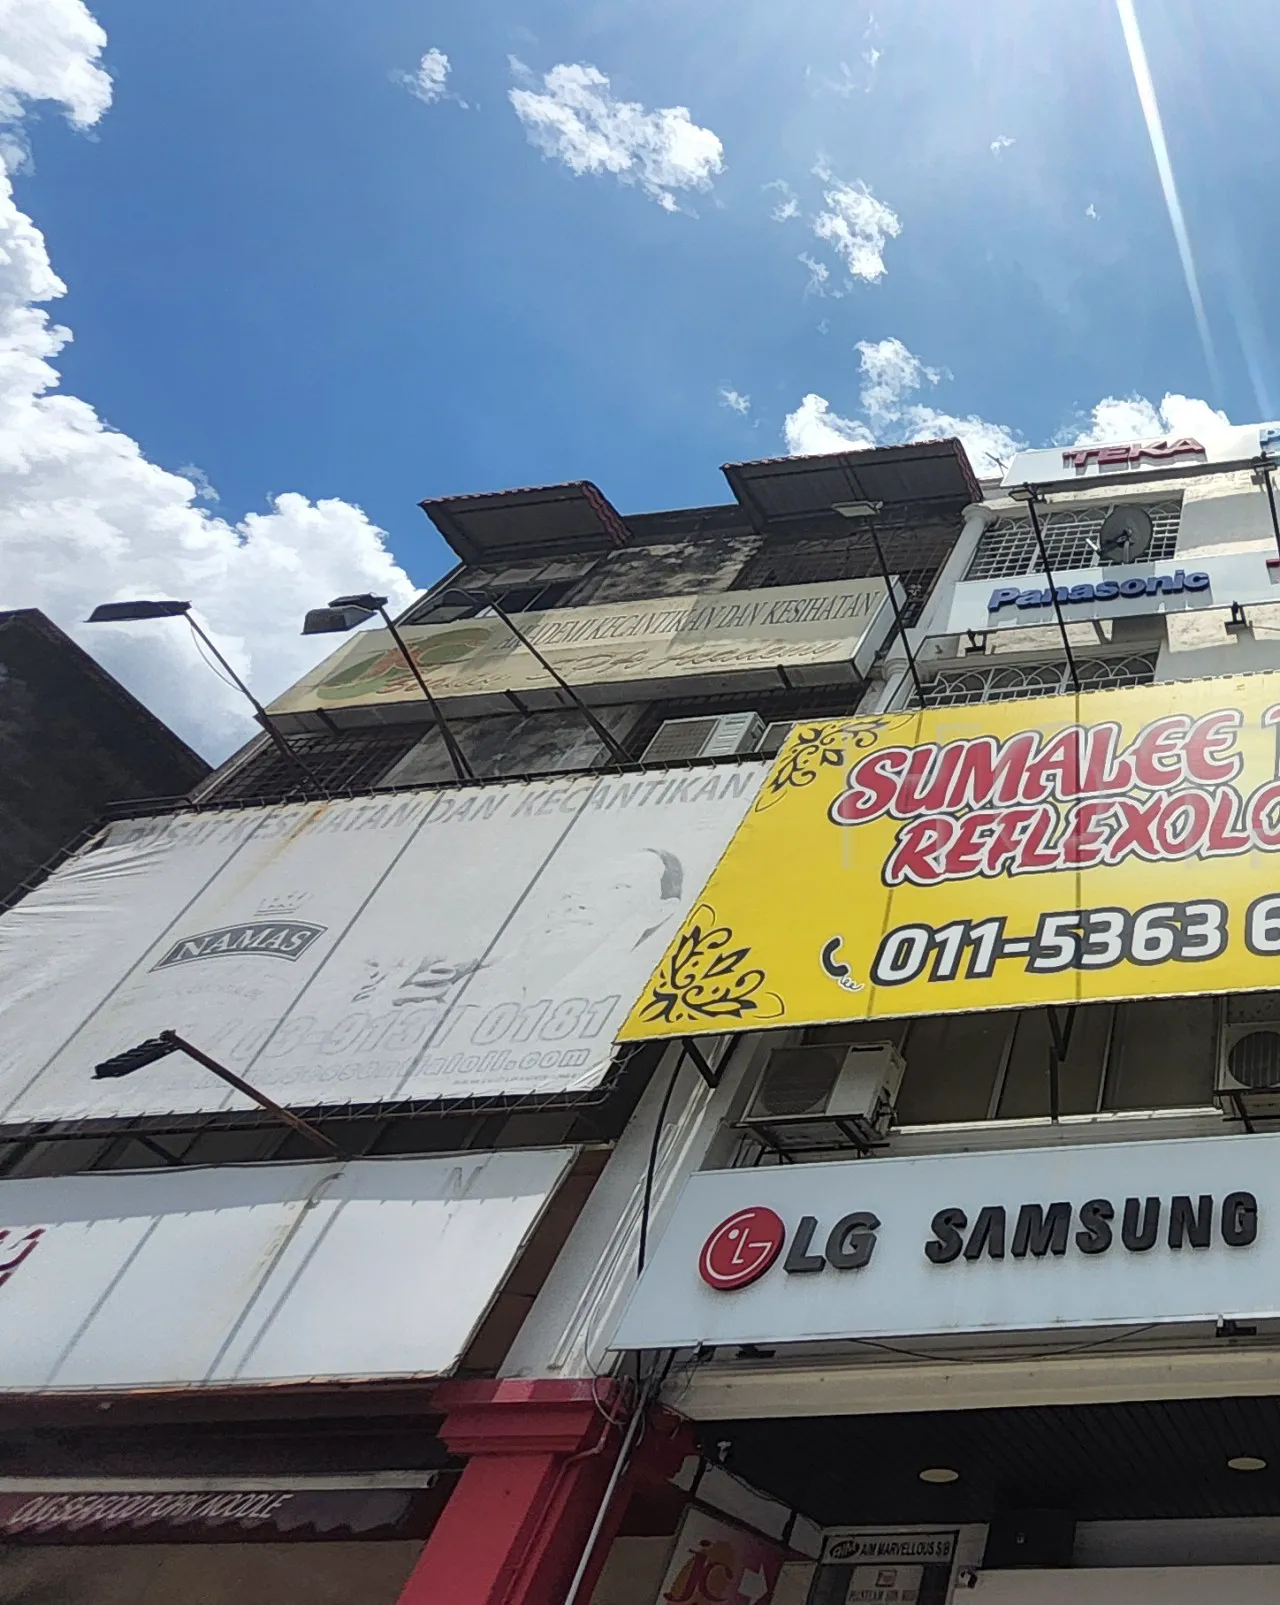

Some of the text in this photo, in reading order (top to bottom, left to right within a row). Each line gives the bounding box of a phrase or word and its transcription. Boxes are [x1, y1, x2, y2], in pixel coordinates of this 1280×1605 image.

[1064, 438, 1205, 468] TEKA
[586, 606, 722, 642] KECANTIKAN
[717, 602, 765, 629] DAN
[761, 591, 882, 626] KESIHATAN
[988, 570, 1210, 612] Panasonic
[830, 709, 1242, 826] SUMALEE
[427, 792, 511, 825] DAN
[510, 772, 755, 818] KECANTIKAN
[175, 926, 311, 961] NAMAS
[871, 900, 1227, 986] 011-5363
[470, 995, 622, 1046] 0181
[783, 1191, 1259, 1274] LG SAMSUNG
[50, 1495, 157, 1522] SEAFOOD
[190, 1493, 294, 1519] NOODLE
[877, 1541, 934, 1556] MARVELLOUS
